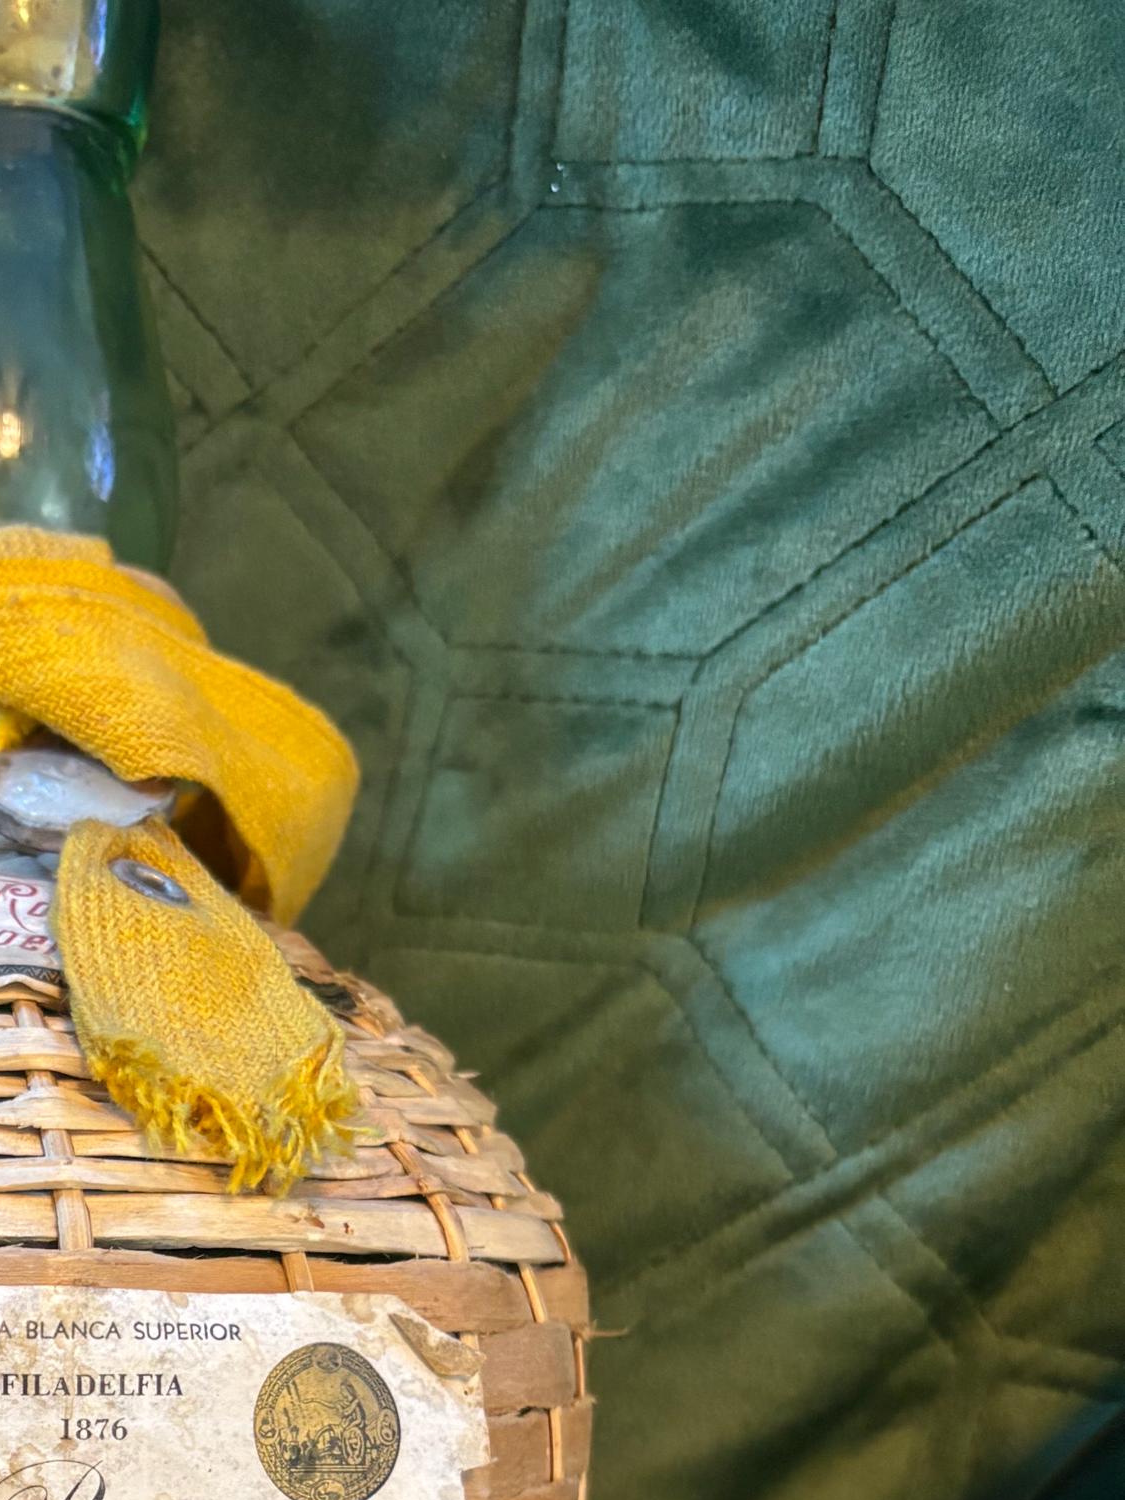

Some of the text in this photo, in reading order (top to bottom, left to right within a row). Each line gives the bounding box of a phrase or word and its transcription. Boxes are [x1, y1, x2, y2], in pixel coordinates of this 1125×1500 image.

[26, 1320, 122, 1341] BLANCA
[133, 1321, 242, 1341] SUPERIOR
[0, 1373, 184, 1397] FILADELFIA
[59, 1417, 129, 1441] 1876
